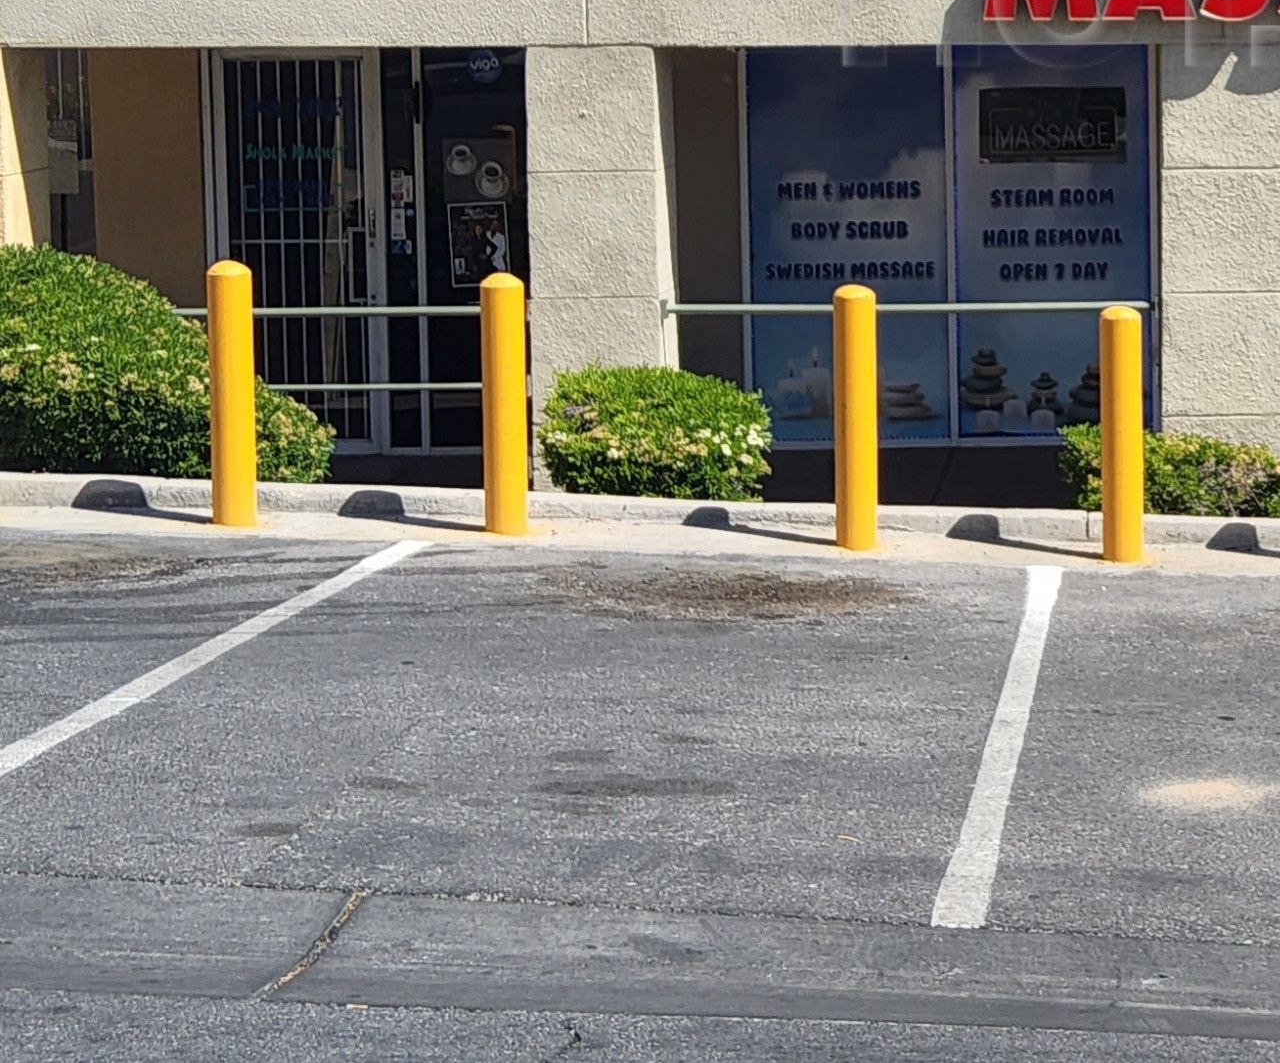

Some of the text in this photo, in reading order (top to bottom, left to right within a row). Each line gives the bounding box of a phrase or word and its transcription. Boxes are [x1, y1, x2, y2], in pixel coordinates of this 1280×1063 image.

[995, 121, 1111, 151] MASSAGE
[778, 181, 818, 201] MEN
[839, 180, 921, 200] WOMENS
[990, 188, 1114, 207] STEAM ROOM
[791, 220, 909, 241] BODY SCRUB
[983, 227, 1124, 248] HAIR REMOVAL
[766, 261, 935, 281] SWEDISH MASSAGE
[1000, 262, 1109, 282] OPEN 7 DAY
